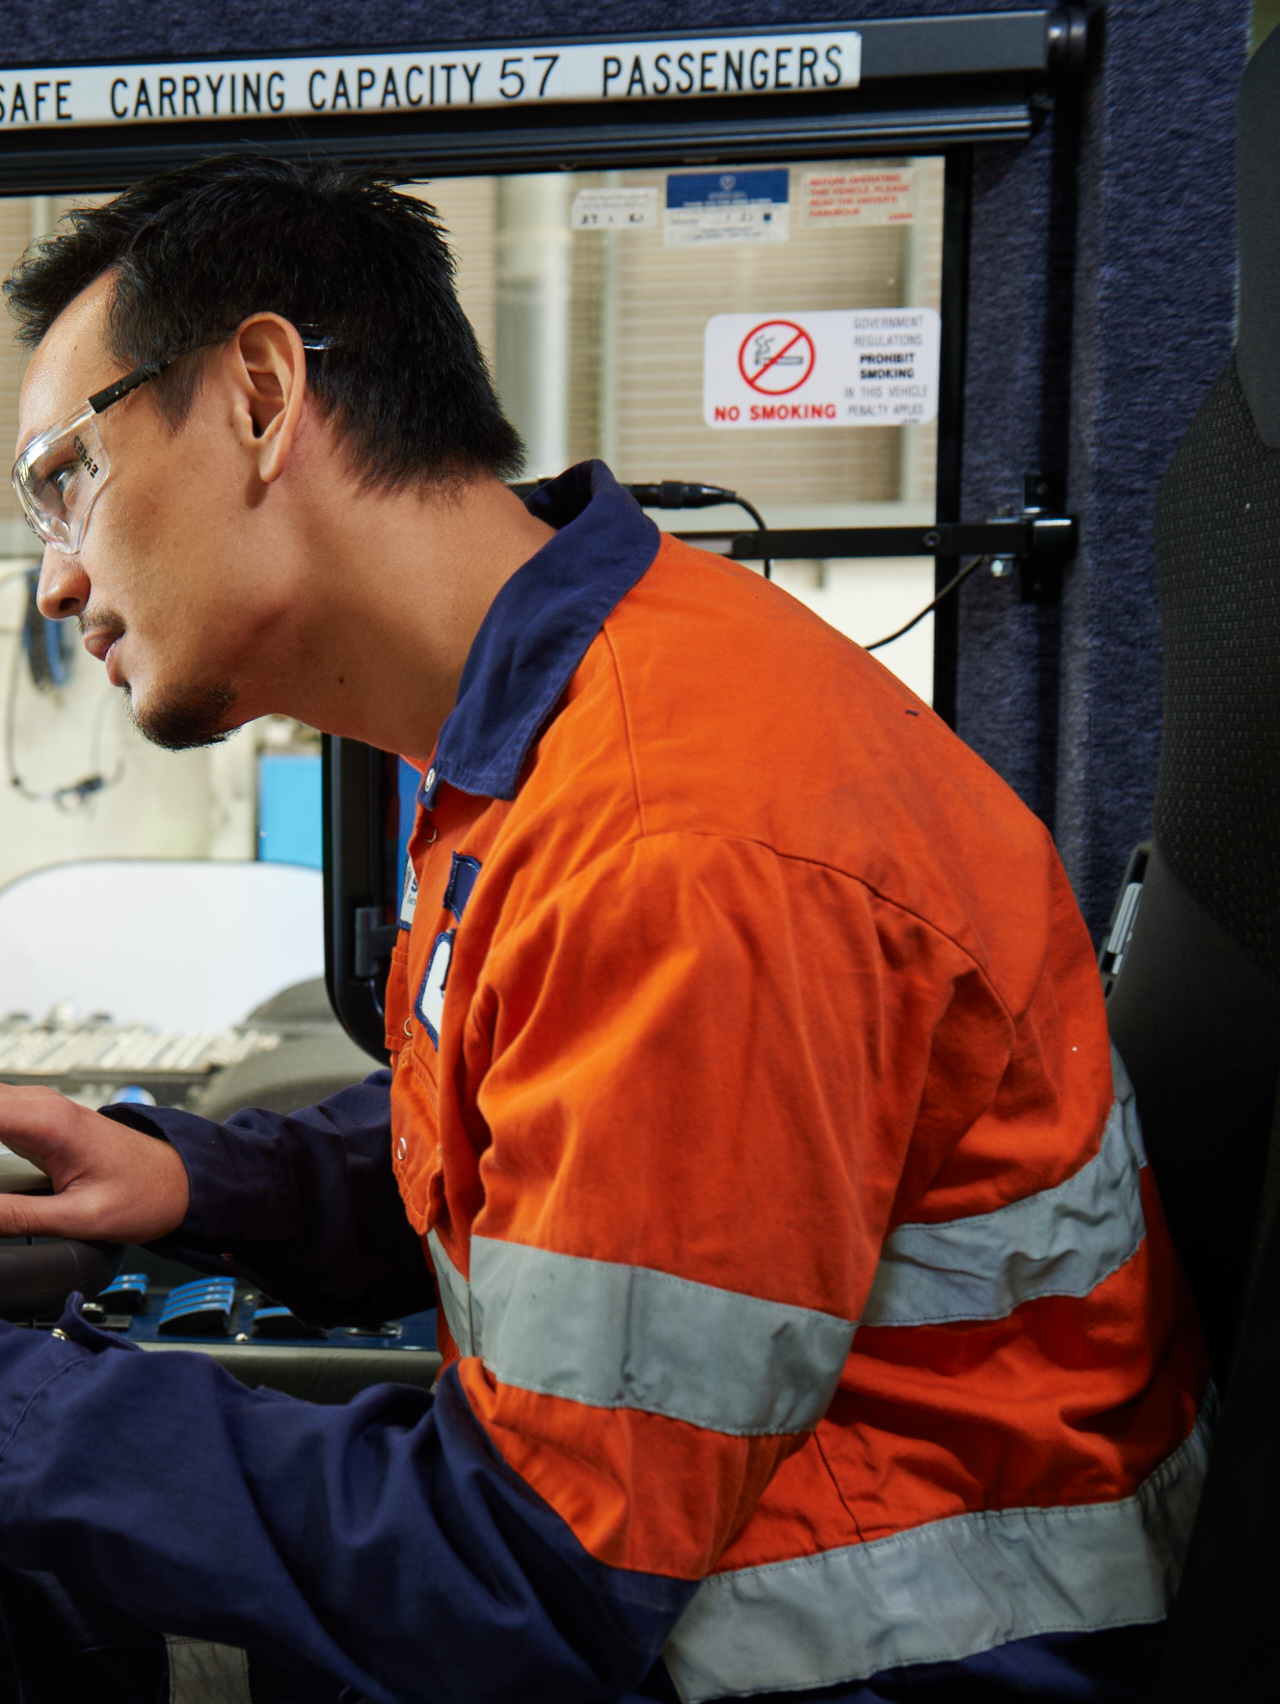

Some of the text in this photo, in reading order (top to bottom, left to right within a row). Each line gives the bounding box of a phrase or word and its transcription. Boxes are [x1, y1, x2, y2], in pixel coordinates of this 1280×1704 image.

[110, 72, 286, 119] CARRYING
[308, 61, 482, 111] CAPACITY
[498, 53, 560, 100] 57
[601, 45, 842, 98] PASSENGERS
[853, 315, 924, 330] GOVERNMENT
[853, 333, 923, 348] REGULATIONS
[859, 352, 916, 365] PROHIBIT
[859, 367, 915, 380] SMOKING
[844, 384, 928, 399] IN THIS VEHICLE
[714, 403, 837, 422] NO SMOKING
[847, 404, 889, 416] PENALTY
